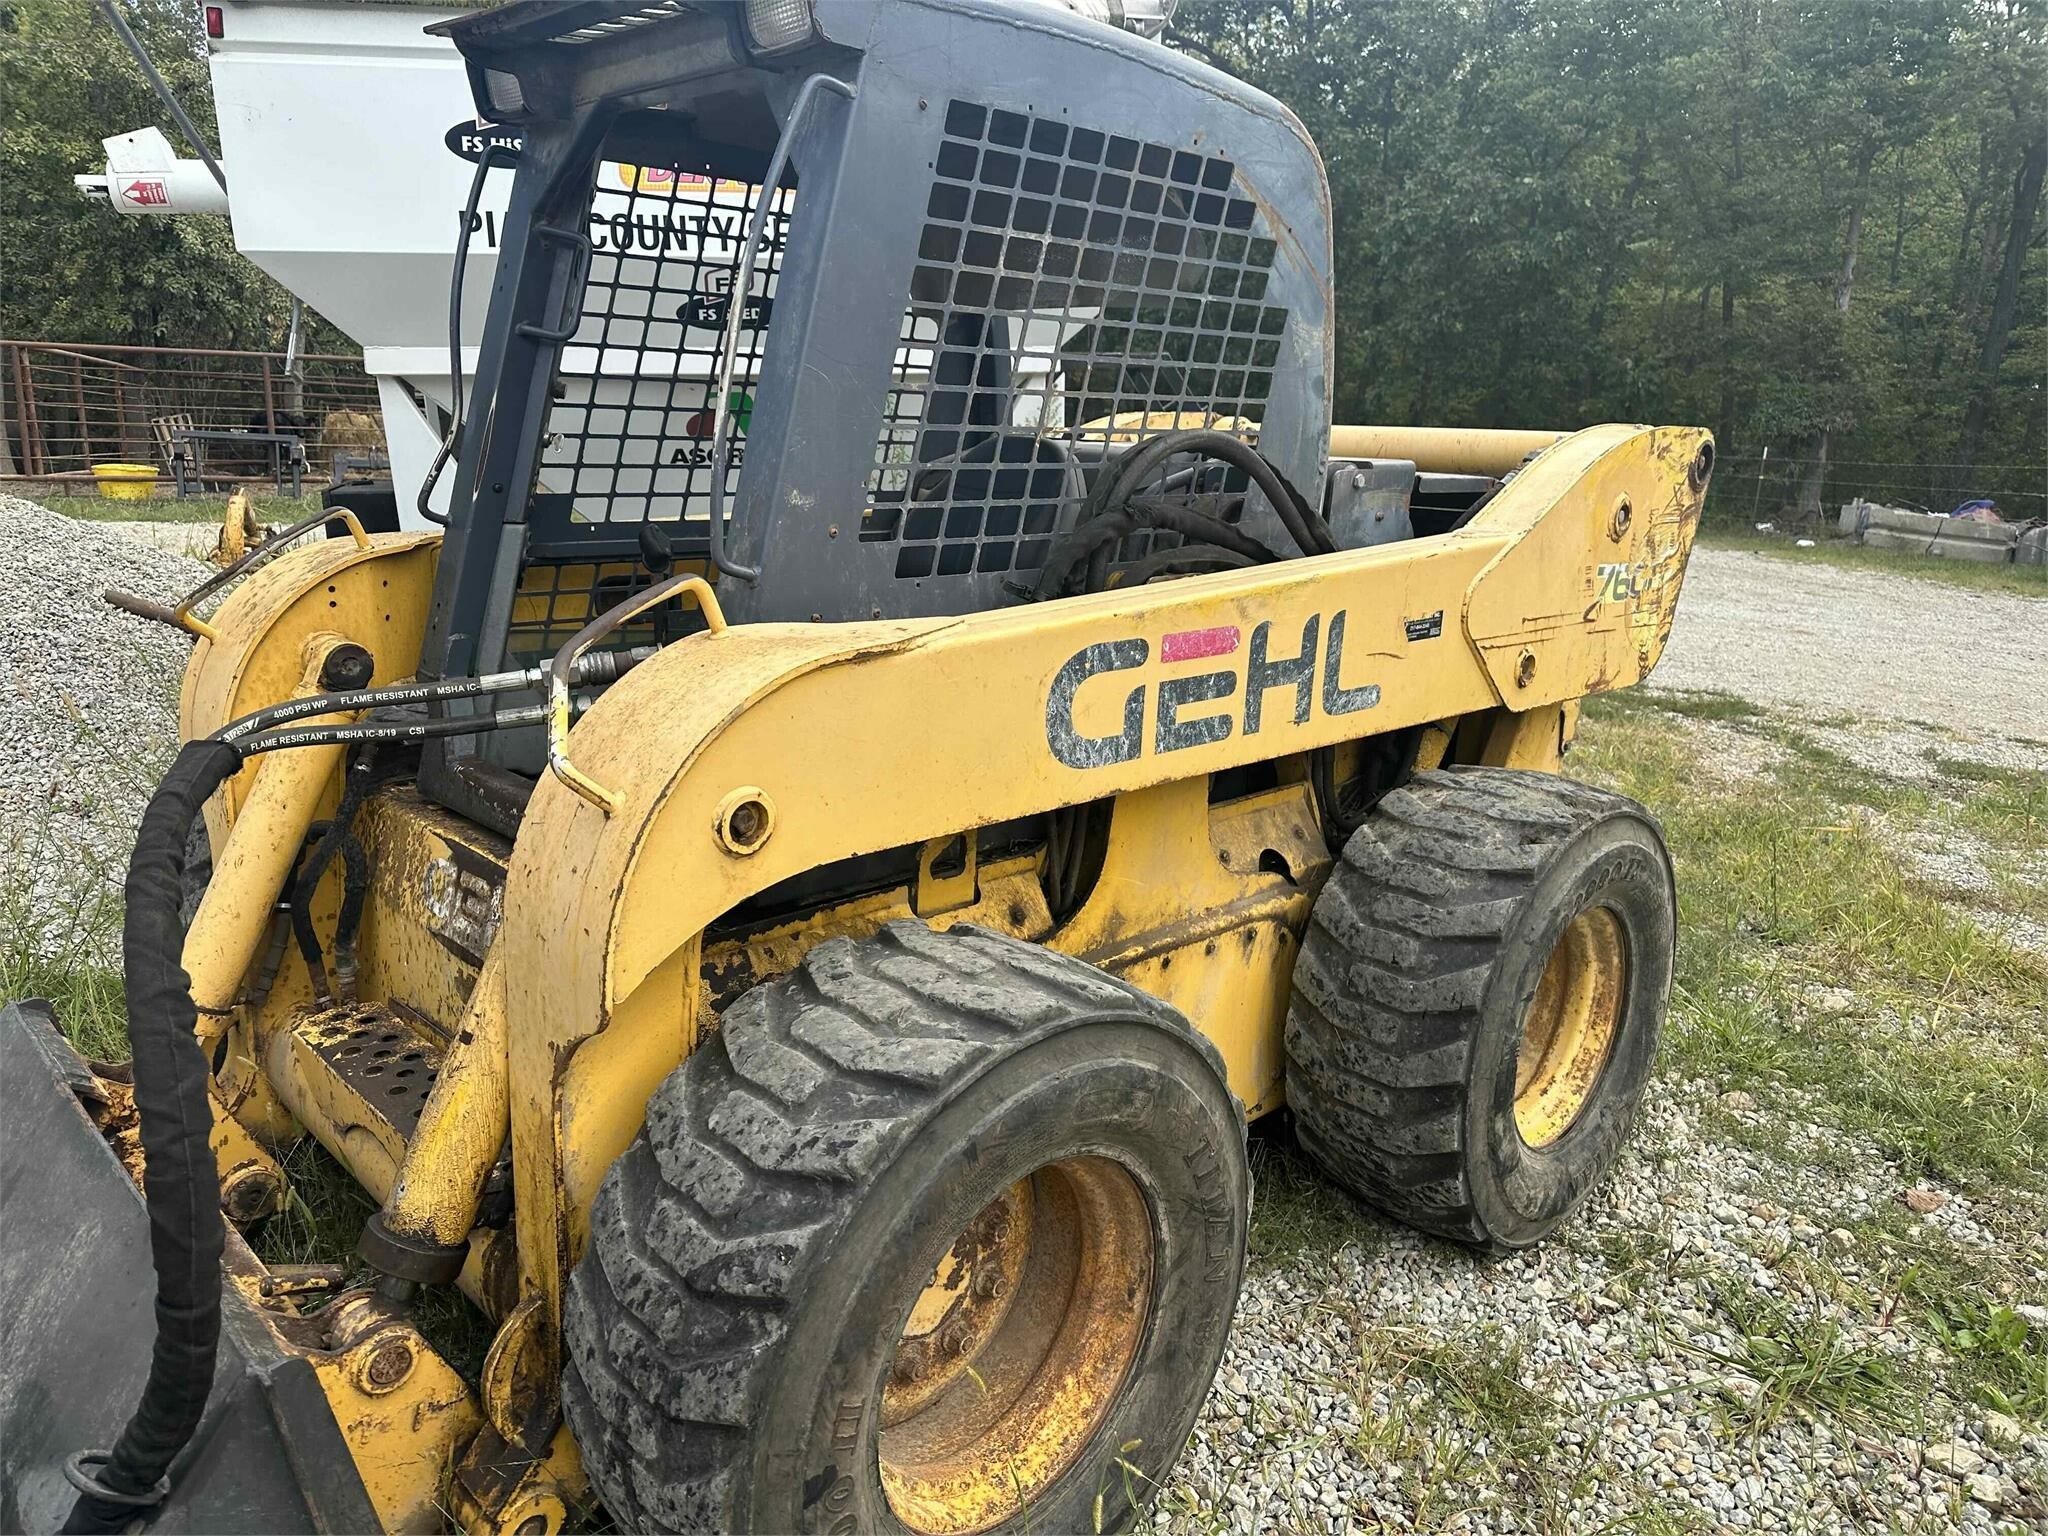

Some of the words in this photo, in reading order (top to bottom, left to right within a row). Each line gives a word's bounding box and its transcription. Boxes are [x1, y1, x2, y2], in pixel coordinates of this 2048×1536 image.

[461, 136, 483, 152] FS
[698, 308, 718, 321] FS
[273, 706, 294, 719] 4000
[295, 702, 311, 714] PSI
[313, 699, 328, 711] WP
[340, 692, 374, 705] FLAME
[375, 688, 429, 701] RESISTANT
[437, 684, 465, 695] MSHA
[1045, 609, 1382, 770] GEHL
[250, 737, 278, 751] FLAME
[279, 731, 329, 745] RESISTANT
[336, 729, 363, 739] MSHA
[365, 728, 397, 738] IC-8/19
[408, 726, 425, 736] CSI
[1182, 1134, 1232, 1284] TITAN
